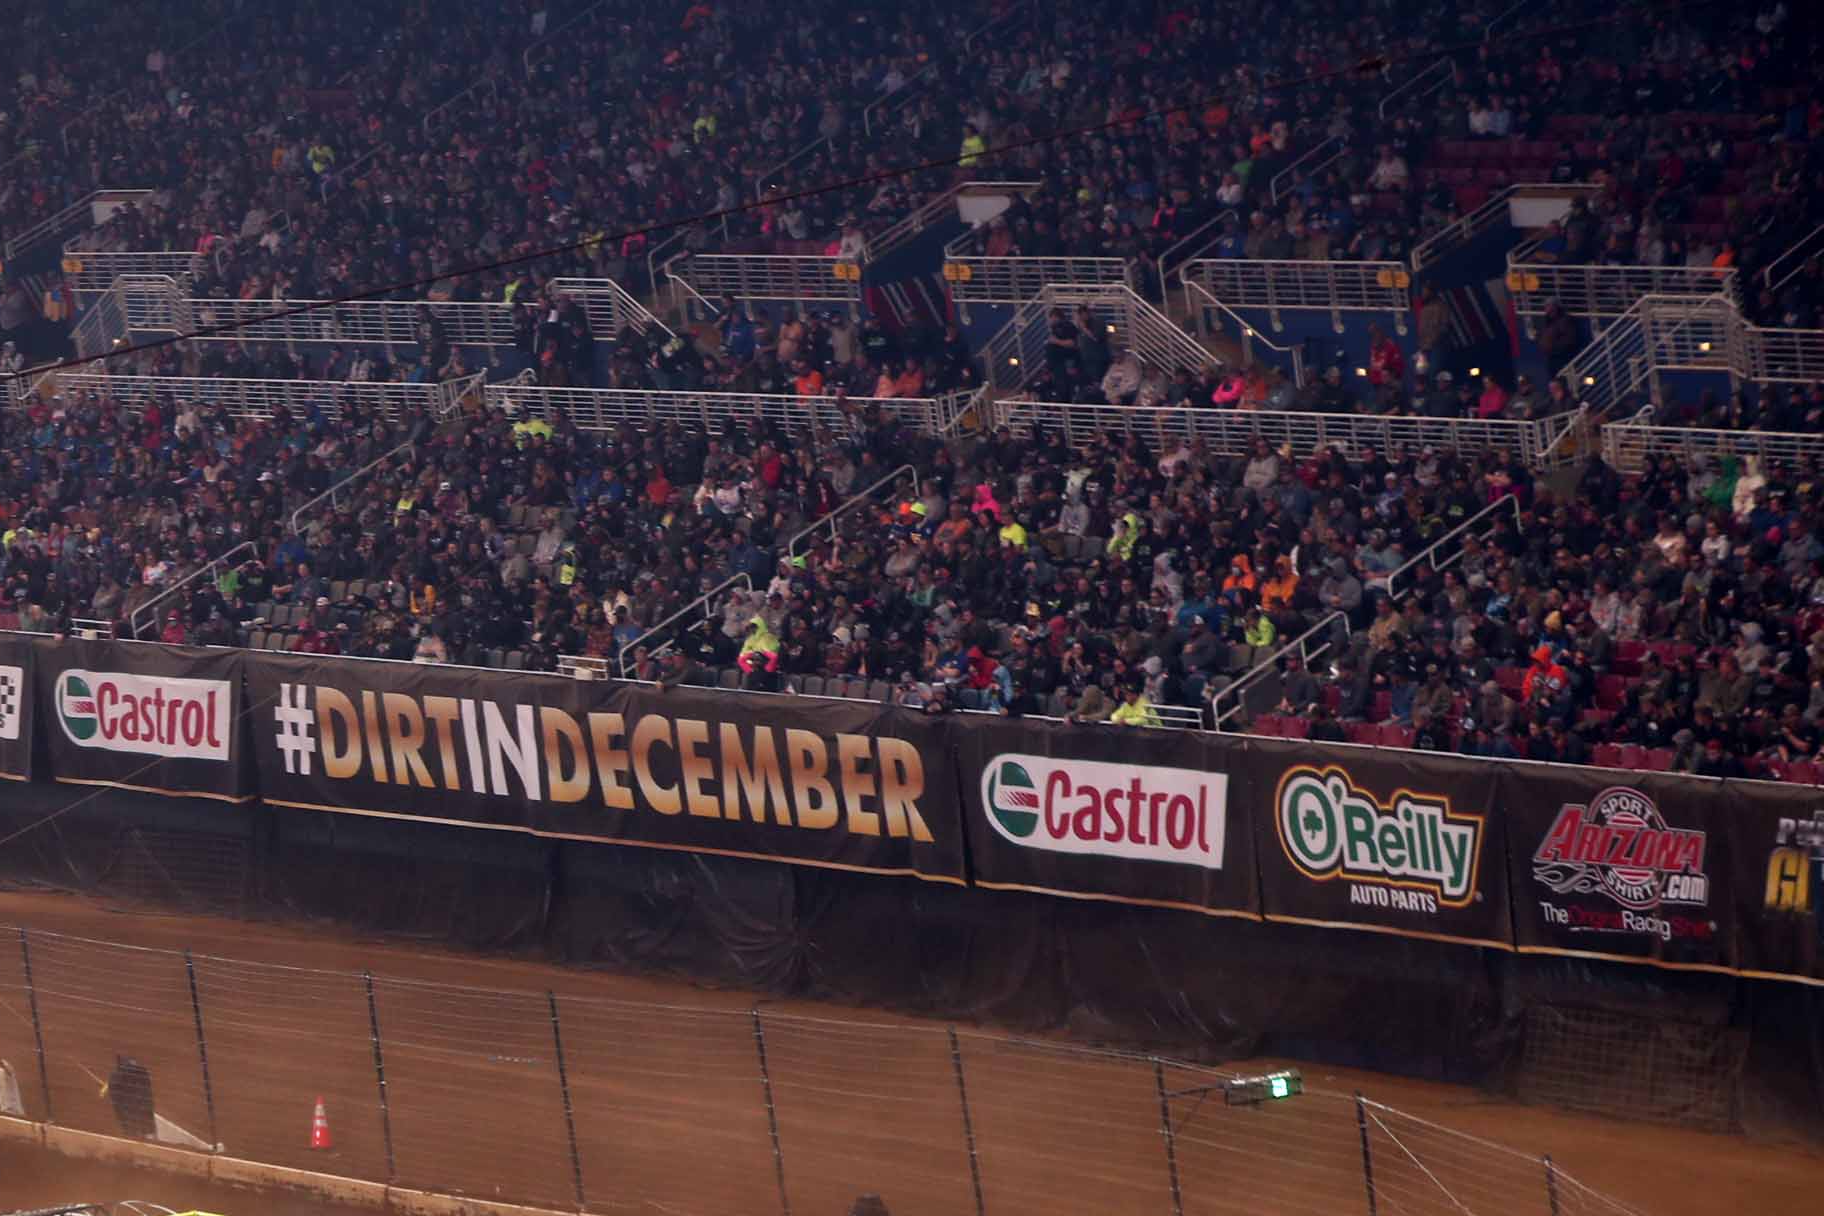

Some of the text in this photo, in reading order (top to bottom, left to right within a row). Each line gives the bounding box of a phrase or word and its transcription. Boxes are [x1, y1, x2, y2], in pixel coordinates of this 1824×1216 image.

[96, 684, 221, 749] Castrol
[274, 682, 935, 843] #DIRTINDECEMBER
[1045, 769, 1210, 854] Castrol
[1600, 795, 1654, 821] SPORT
[1287, 775, 1474, 889] O'Reilly
[1534, 804, 1706, 873] ARIZONA
[1350, 884, 1437, 913] AUTO PARTS
[1606, 872, 1656, 901] SHIRT
[1540, 902, 1569, 924] The
[1622, 911, 1671, 941] Racing
